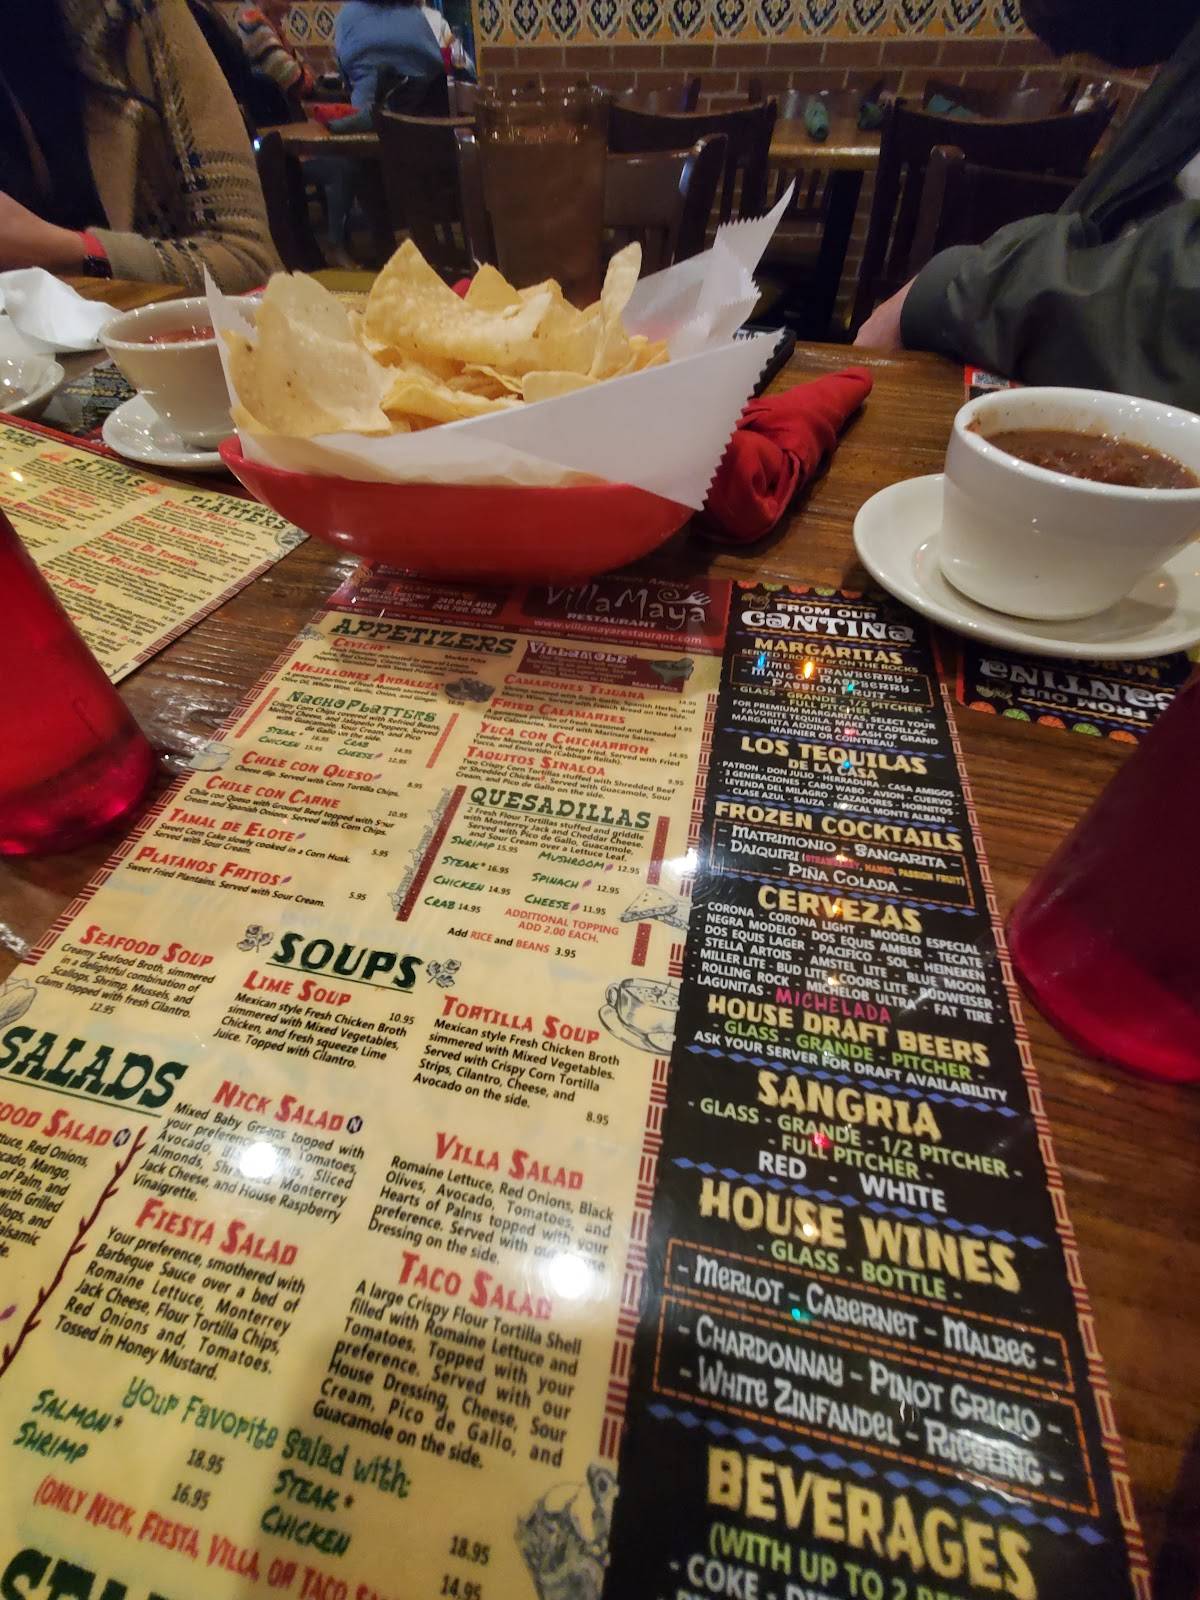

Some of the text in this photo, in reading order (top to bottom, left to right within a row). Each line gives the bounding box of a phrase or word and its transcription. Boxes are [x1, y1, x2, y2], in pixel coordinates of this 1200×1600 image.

[184, 495, 290, 530] PLATTERS
[545, 585, 706, 627] Villa Maya
[567, 613, 656, 628] RESTAURANT
[777, 603, 877, 620] FROM OUR
[331, 619, 517, 654] APPETIZERS
[755, 638, 903, 665] MARGARITAS
[504, 674, 645, 700] CAMARONES TIJUANA
[491, 698, 626, 724] FRIED CALAMARIES
[480, 722, 649, 754] YUCA CON CHICHARRON
[741, 736, 928, 775] LOS TEQUILAS
[242, 751, 374, 783] CHILE CON QUESO
[467, 745, 605, 776] TAQUITOS SINALOA
[788, 758, 878, 780] DE LA CASA
[205, 775, 341, 809] CHILE CON CARNE
[470, 787, 651, 829] QUESADILLAS
[169, 808, 295, 842] TAMAL DE ELOTE
[715, 801, 964, 851] FROZEN COCKTAILS
[451, 836, 519, 854] SHRIMP 15.95
[538, 851, 640, 875] MUSHROOM 12.95
[731, 824, 836, 852] MATRIMONIO
[854, 843, 947, 869] SANGARITA
[731, 840, 800, 861] DAIQUIRI
[136, 846, 282, 886] PLATANOS FRITOS
[488, 864, 510, 874] 16.95
[532, 873, 620, 894] SPINACH 12.95
[789, 862, 828, 882] PIÑA
[833, 871, 899, 893] COLADA
[434, 875, 511, 896] CHICKEN 14.95
[424, 896, 481, 913] CRAB 14.95
[505, 908, 619, 936] ADDITIONAL TOPPING
[525, 894, 606, 915] CHEESE 11.95
[758, 884, 923, 934] CERVEZAS
[80, 924, 214, 968] SEAFOOD SOUP
[448, 927, 576, 958] Add RICE and BEANS 3.95
[519, 921, 599, 943] ADD 2.00 EACH.
[707, 902, 981, 956] CORONA CORONA LIGHT MODELO ESPECIAL
[273, 931, 426, 990] SOUPS
[243, 970, 352, 1007] LIME SOUP
[775, 987, 892, 1024] MICHELADA
[90, 1003, 115, 1015] 12.95
[389, 1012, 415, 1025] 10.95
[441, 995, 600, 1045] TORTILLA SOUP
[434, 1019, 620, 1067] Mexican style Fresh Chicken Broth
[707, 994, 990, 1067] HOUSE DRAFT BEERS
[0, 1025, 188, 1109] SALADS
[694, 1030, 1008, 1102] ASK YOUR SERVER FOR DRAFT AVAILABILITY
[724, 1020, 972, 1080] GLASS GRANDE PITCHER
[212, 1081, 344, 1132] NICK SALAD
[586, 1112, 609, 1127] 8.95
[758, 1069, 942, 1142] SANGRIA
[700, 1098, 1009, 1179] GLASS GRANDE 1/2 PITCHER
[436, 1132, 584, 1191] VILLA SALAD
[781, 1135, 920, 1181] FULL PITCHER
[758, 1151, 948, 1213] RED WHITE
[135, 1196, 298, 1266] FIESTA SALAD
[699, 1177, 1022, 1294] HOUSE WINES
[398, 1251, 553, 1320] TACO SALAD
[771, 1241, 947, 1301] GLASS BOTTLE
[696, 1316, 1042, 1438] CHARDONNAY PINOT GRIGIO
[13, 1422, 210, 1511] SHRIMP 16.95
[186, 1447, 224, 1476] 18.95
[707, 1446, 1038, 1599] BEVERAGES
[260, 1507, 483, 1600] CHICKEN 14.95
[448, 1535, 490, 1564] 18.95
